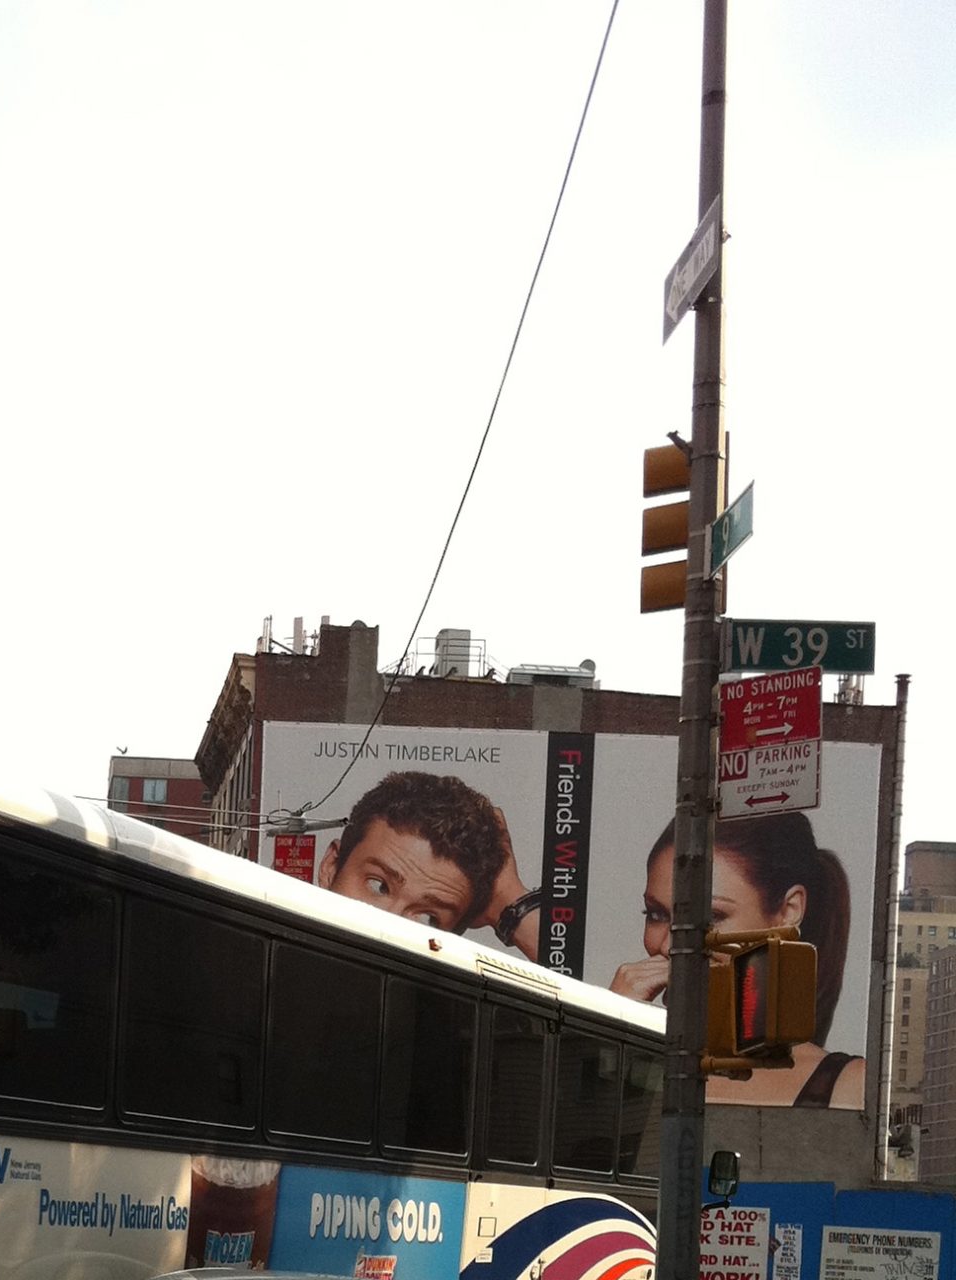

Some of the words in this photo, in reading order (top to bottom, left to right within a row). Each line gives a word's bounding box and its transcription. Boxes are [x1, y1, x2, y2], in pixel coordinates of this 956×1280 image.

[736, 627, 765, 665] W
[781, 626, 829, 667] 39
[845, 628, 867, 649] ST
[727, 684, 744, 700] NO
[751, 672, 814, 696] STANDING
[314, 741, 379, 759] JUSTIN
[385, 744, 501, 763] TIMBERLAKE
[721, 752, 747, 777] NO
[755, 744, 811, 765] PARKING
[556, 750, 582, 835] Friends
[737, 784, 767, 794] EXCEPT
[769, 778, 800, 790] SUNDAY
[553, 840, 578, 899] With
[10, 1169, 30, 1181] Natural
[38, 1188, 98, 1227] Powered
[100, 1193, 117, 1237] by
[119, 1194, 164, 1230] Natural
[167, 1196, 188, 1231] Gas
[309, 1192, 381, 1241] PIPING
[386, 1198, 443, 1243] COLD.
[715, 1210, 725, 1220] A
[731, 1210, 766, 1221] 100%
[720, 1221, 754, 1232] HAT
[204, 1230, 255, 1264] FROZEN
[718, 1235, 760, 1247] SITE.
[828, 1232, 870, 1245] EMERGENCY
[872, 1234, 896, 1246] PHONE
